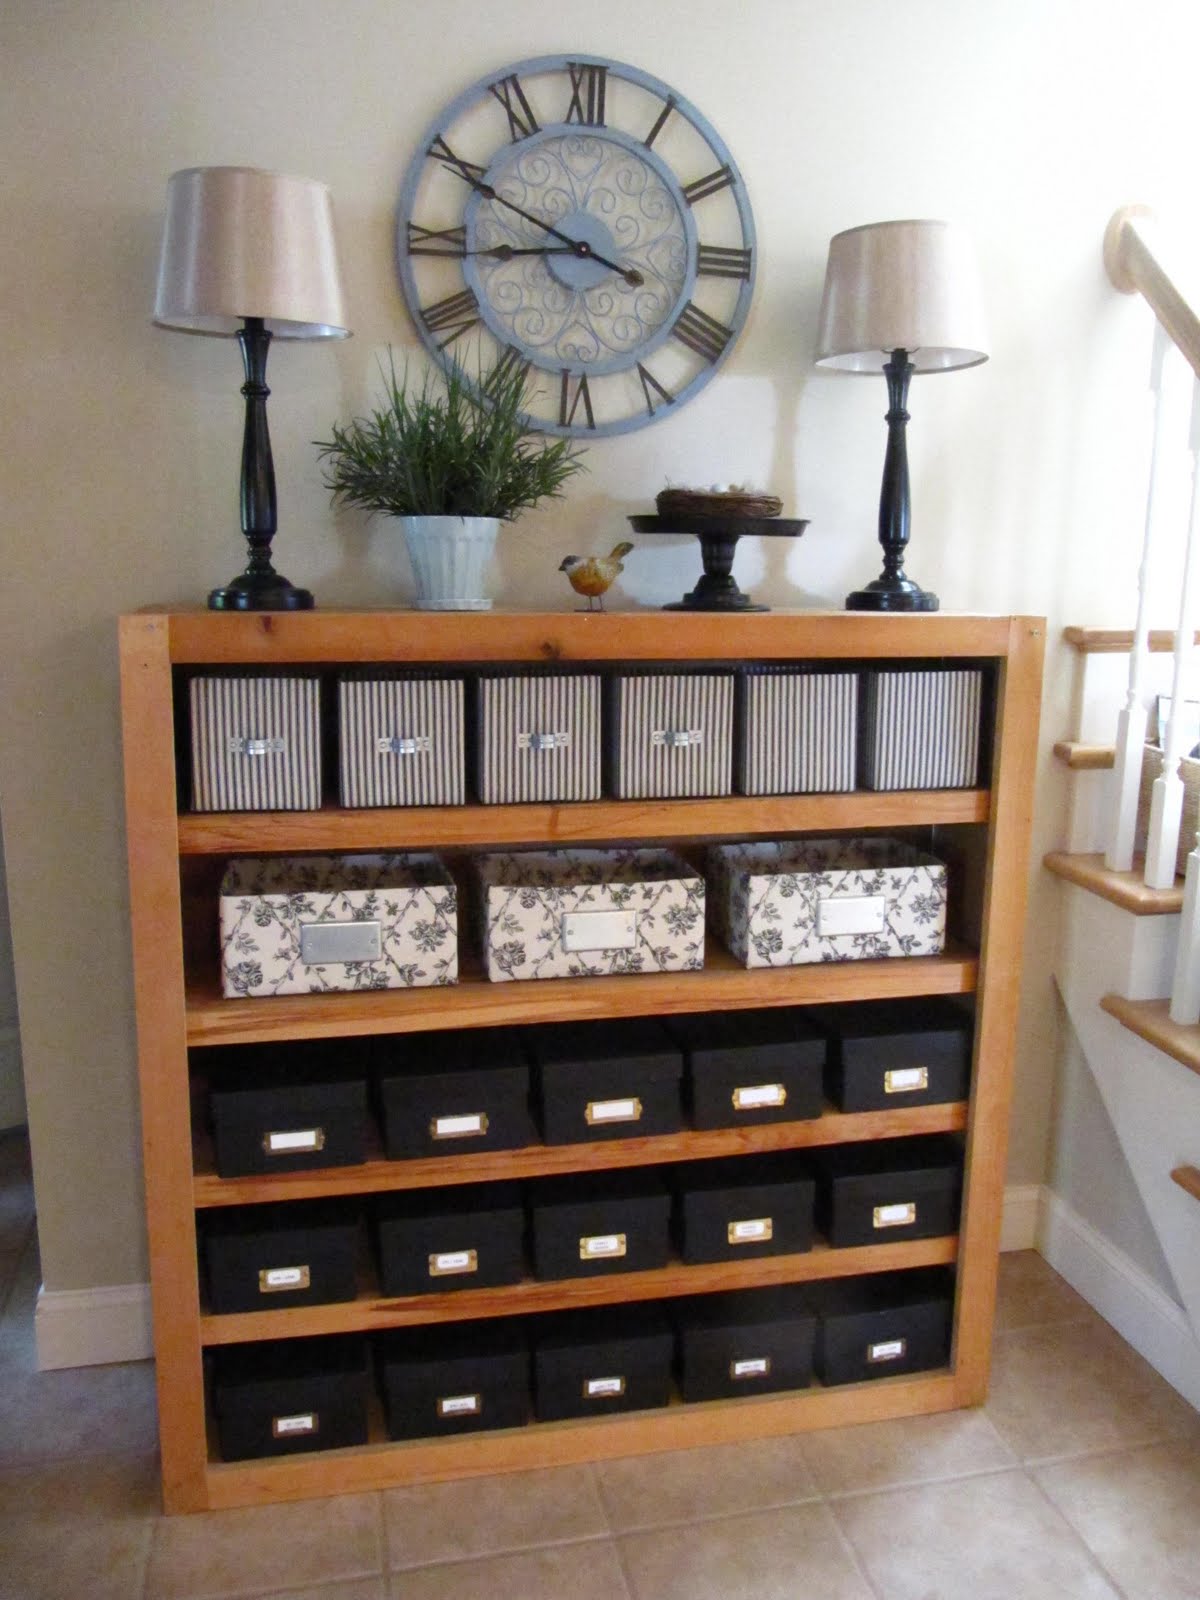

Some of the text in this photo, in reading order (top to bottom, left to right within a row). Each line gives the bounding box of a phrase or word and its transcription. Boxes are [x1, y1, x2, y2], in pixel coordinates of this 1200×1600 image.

[487, 73, 542, 143] XI
[564, 62, 610, 128] XII
[643, 93, 680, 152] I
[426, 133, 491, 191] X
[679, 164, 736, 208] II
[407, 220, 467, 259] IX
[696, 241, 752, 281] III
[420, 286, 482, 352] VIII
[668, 299, 735, 365] IIII
[557, 368, 597, 429] VI
[635, 360, 677, 416] V
